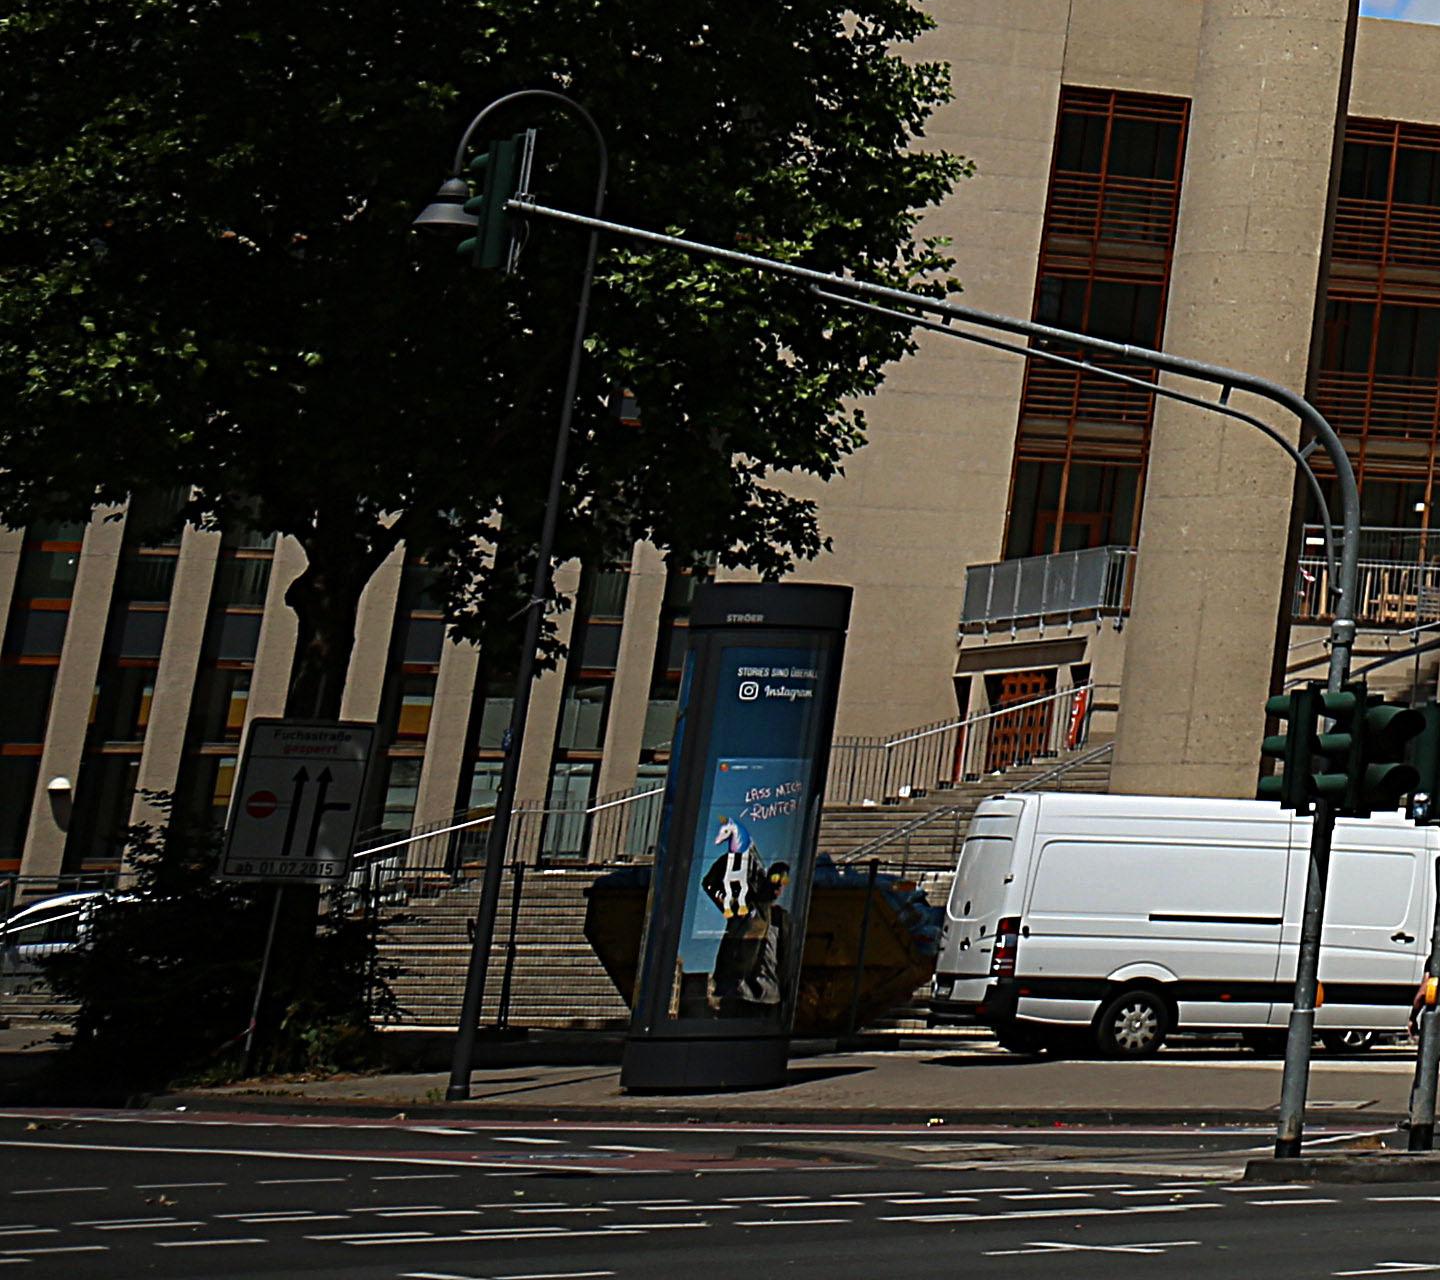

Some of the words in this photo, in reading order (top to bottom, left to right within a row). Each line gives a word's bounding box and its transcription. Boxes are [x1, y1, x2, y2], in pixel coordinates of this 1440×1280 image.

[737, 667, 770, 677] STORIES
[764, 684, 813, 702] Instagram
[273, 728, 352, 742] Fuchsstraße
[745, 787, 771, 803] LASS
[259, 862, 335, 875] 01.07.2015
